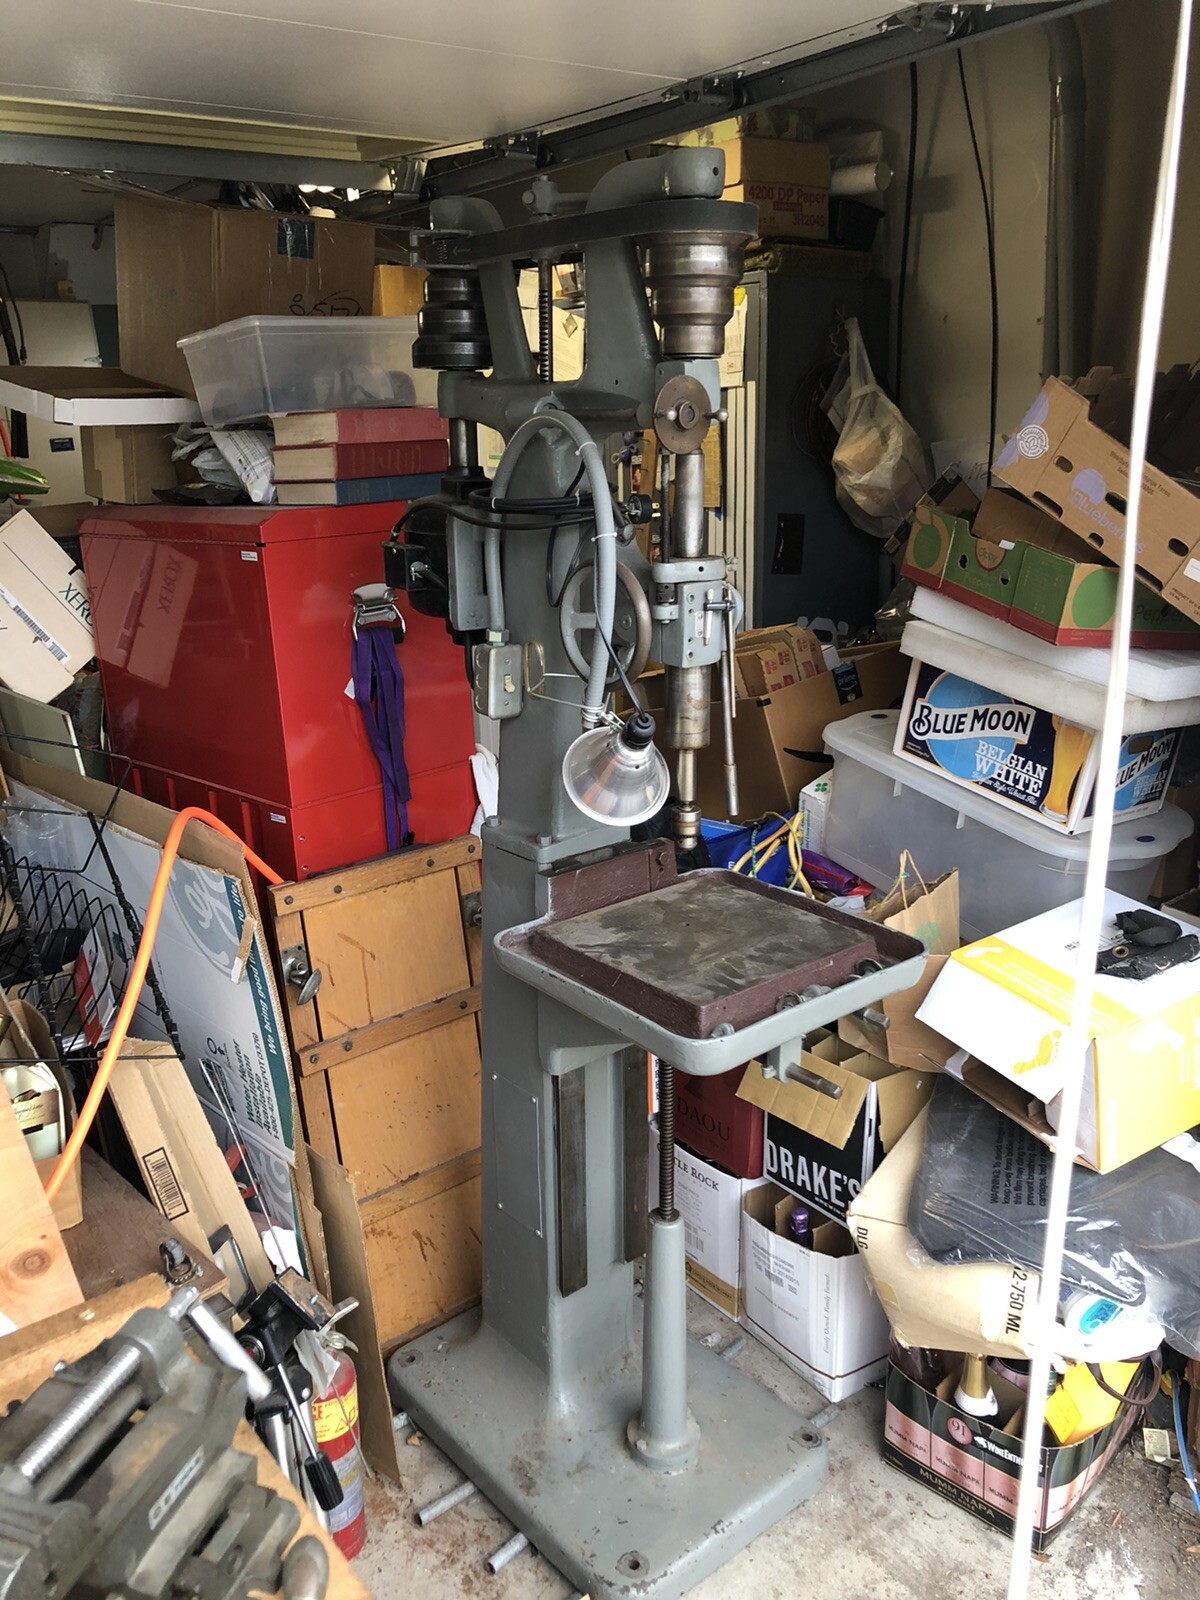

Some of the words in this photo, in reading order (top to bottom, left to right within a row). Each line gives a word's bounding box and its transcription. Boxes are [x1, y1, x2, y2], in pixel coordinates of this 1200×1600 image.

[749, 185, 774, 200] 4200
[778, 187, 794, 202] DP
[797, 188, 826, 206] Paper
[792, 213, 825, 228] 3R2049
[912, 704, 968, 736] BLUE
[969, 707, 1031, 736] MOON
[976, 740, 1048, 780] BELGIAN
[1137, 737, 1174, 774] MOON
[975, 753, 1043, 798] WHITE
[1133, 780, 1166, 799] WHITE
[252, 972, 267, 999] good
[258, 1000, 275, 1035] bring
[267, 1035, 278, 1055] We
[232, 1039, 248, 1082] Heater
[243, 1054, 264, 1130] Installation
[244, 1085, 257, 1124] Water
[255, 1073, 273, 1135] Available
[677, 1097, 731, 1142] DAOU
[690, 1166, 720, 1192] ROCK
[765, 1137, 861, 1208] DRAKE'S
[1002, 1188, 1012, 1205] keep
[1027, 1181, 1036, 1206] prevent
[856, 1226, 869, 1250] DLG
[1004, 1313, 1022, 1335] ML
[888, 1423, 908, 1443] MUMM
[908, 1439, 927, 1454] NAPA
[951, 1420, 966, 1437] 91
[935, 1455, 958, 1472] MUMM
[959, 1470, 980, 1485] NAPA
[919, 1467, 958, 1496] MUMM
[959, 1491, 996, 1519] NAPA
[988, 1486, 1014, 1505] MUMM
